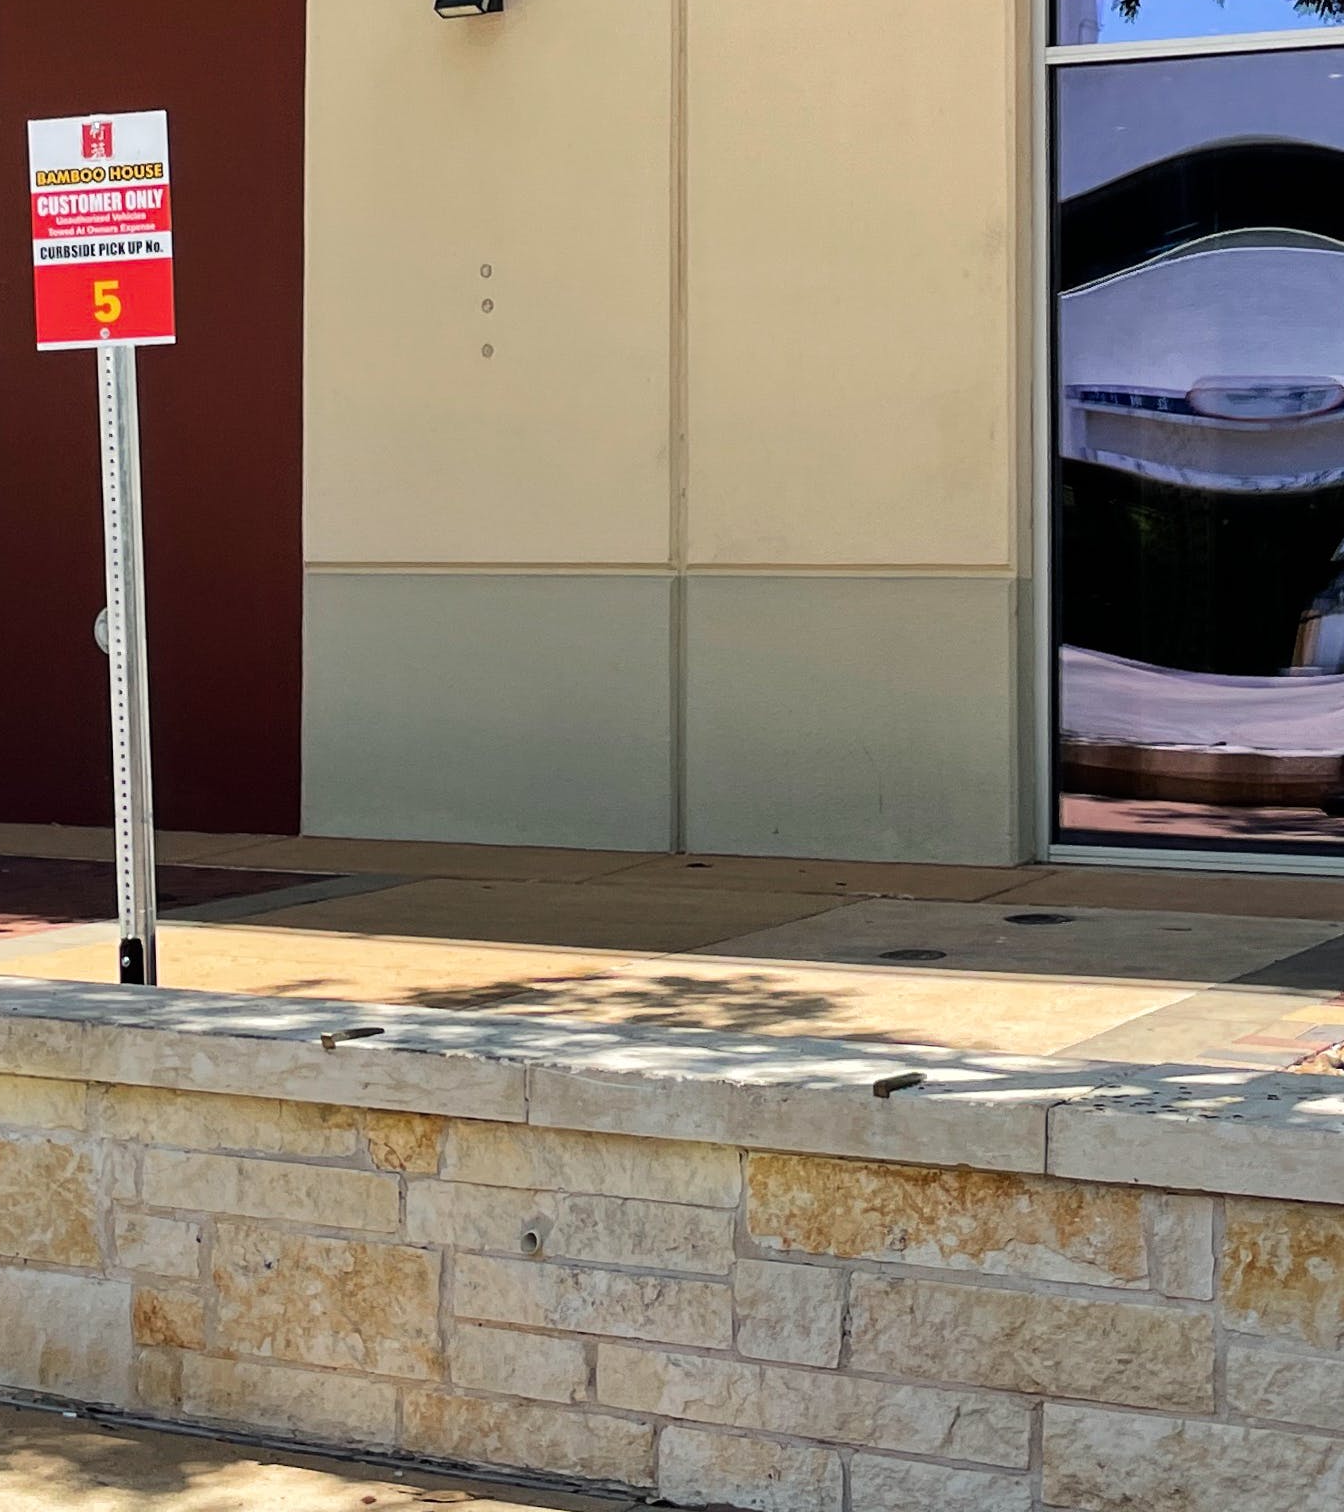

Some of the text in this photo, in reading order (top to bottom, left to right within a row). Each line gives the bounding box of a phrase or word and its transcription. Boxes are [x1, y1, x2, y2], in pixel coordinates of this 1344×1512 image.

[36, 163, 163, 185] BAMBOO HOUSE
[37, 189, 163, 215] CUSTOMER ONLY
[40, 243, 95, 259] CURBSIDE
[98, 241, 125, 256] PICK
[127, 240, 142, 253] UP
[93, 280, 121, 322] 5
